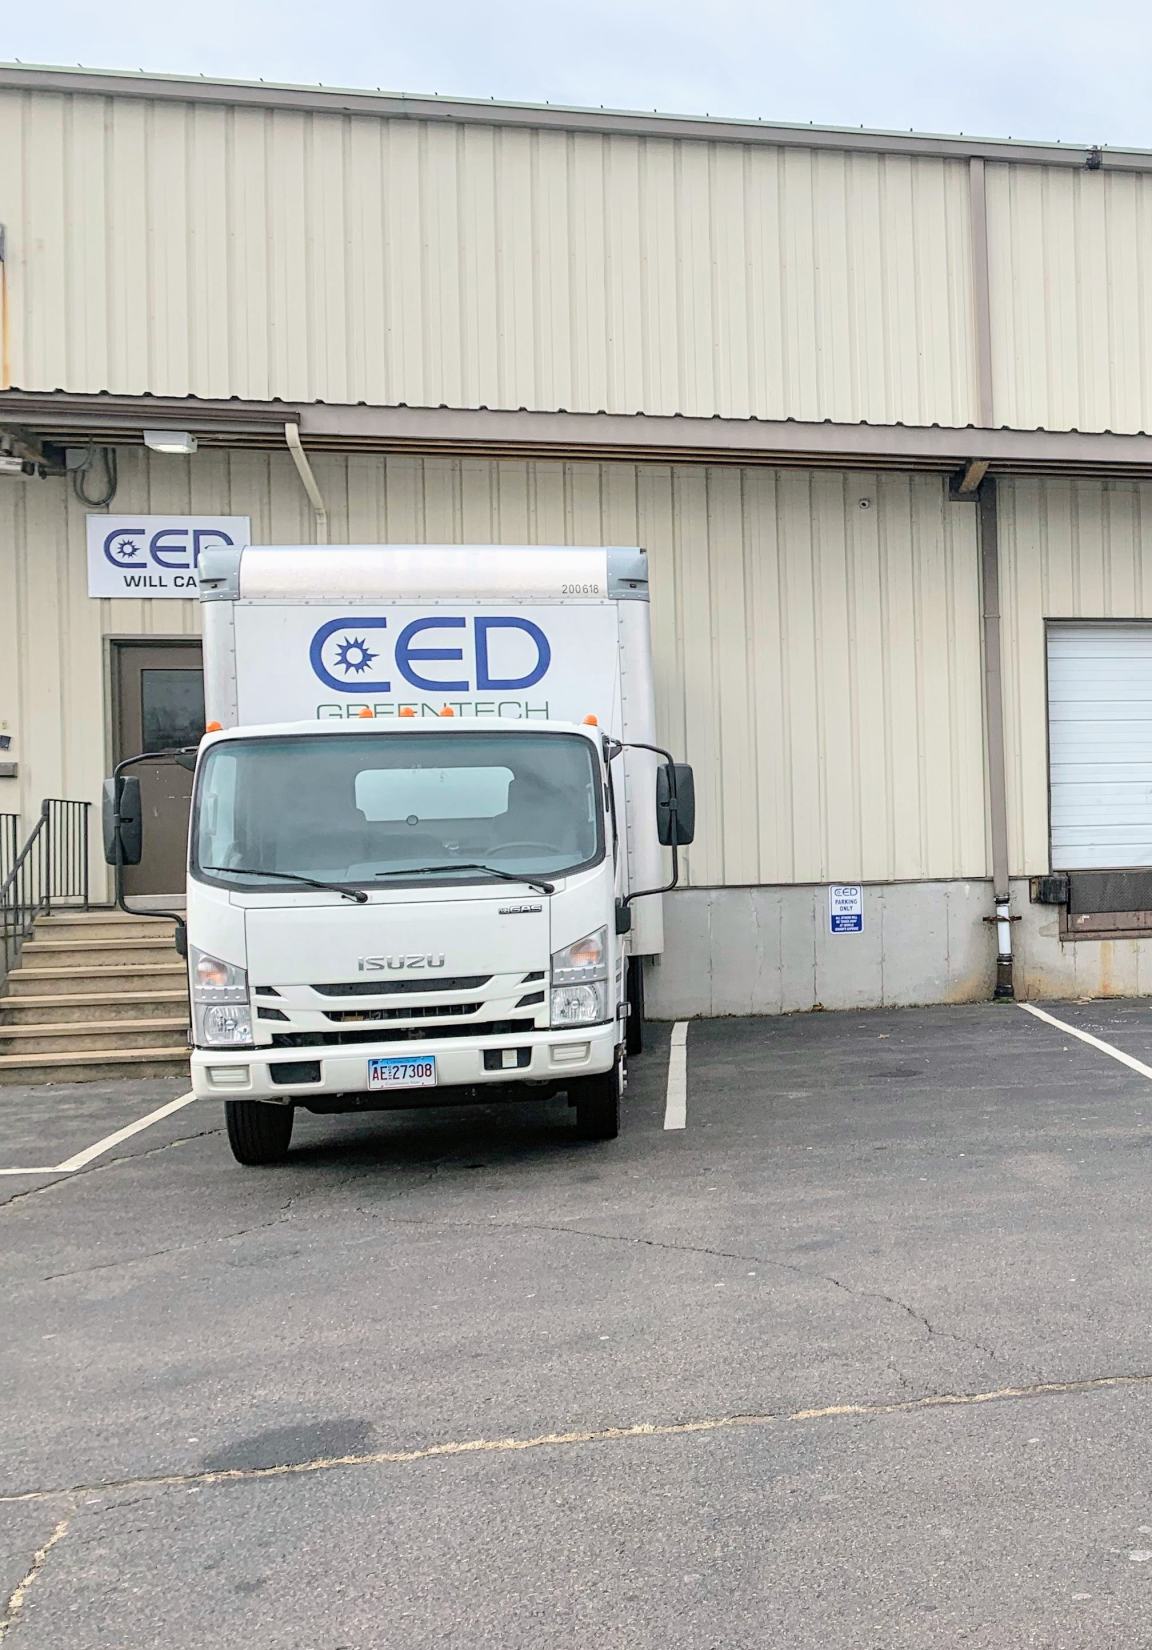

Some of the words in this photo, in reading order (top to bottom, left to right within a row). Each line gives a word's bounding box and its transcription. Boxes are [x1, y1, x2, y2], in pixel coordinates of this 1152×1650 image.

[123, 575, 168, 588] WILL
[173, 575, 198, 588] CA
[561, 584, 599, 594] 200618
[309, 616, 551, 693] CED
[834, 888, 858, 896] CED
[510, 904, 542, 913] GAS
[358, 953, 445, 971] ISUZU
[392, 1063, 432, 1080] 27308
